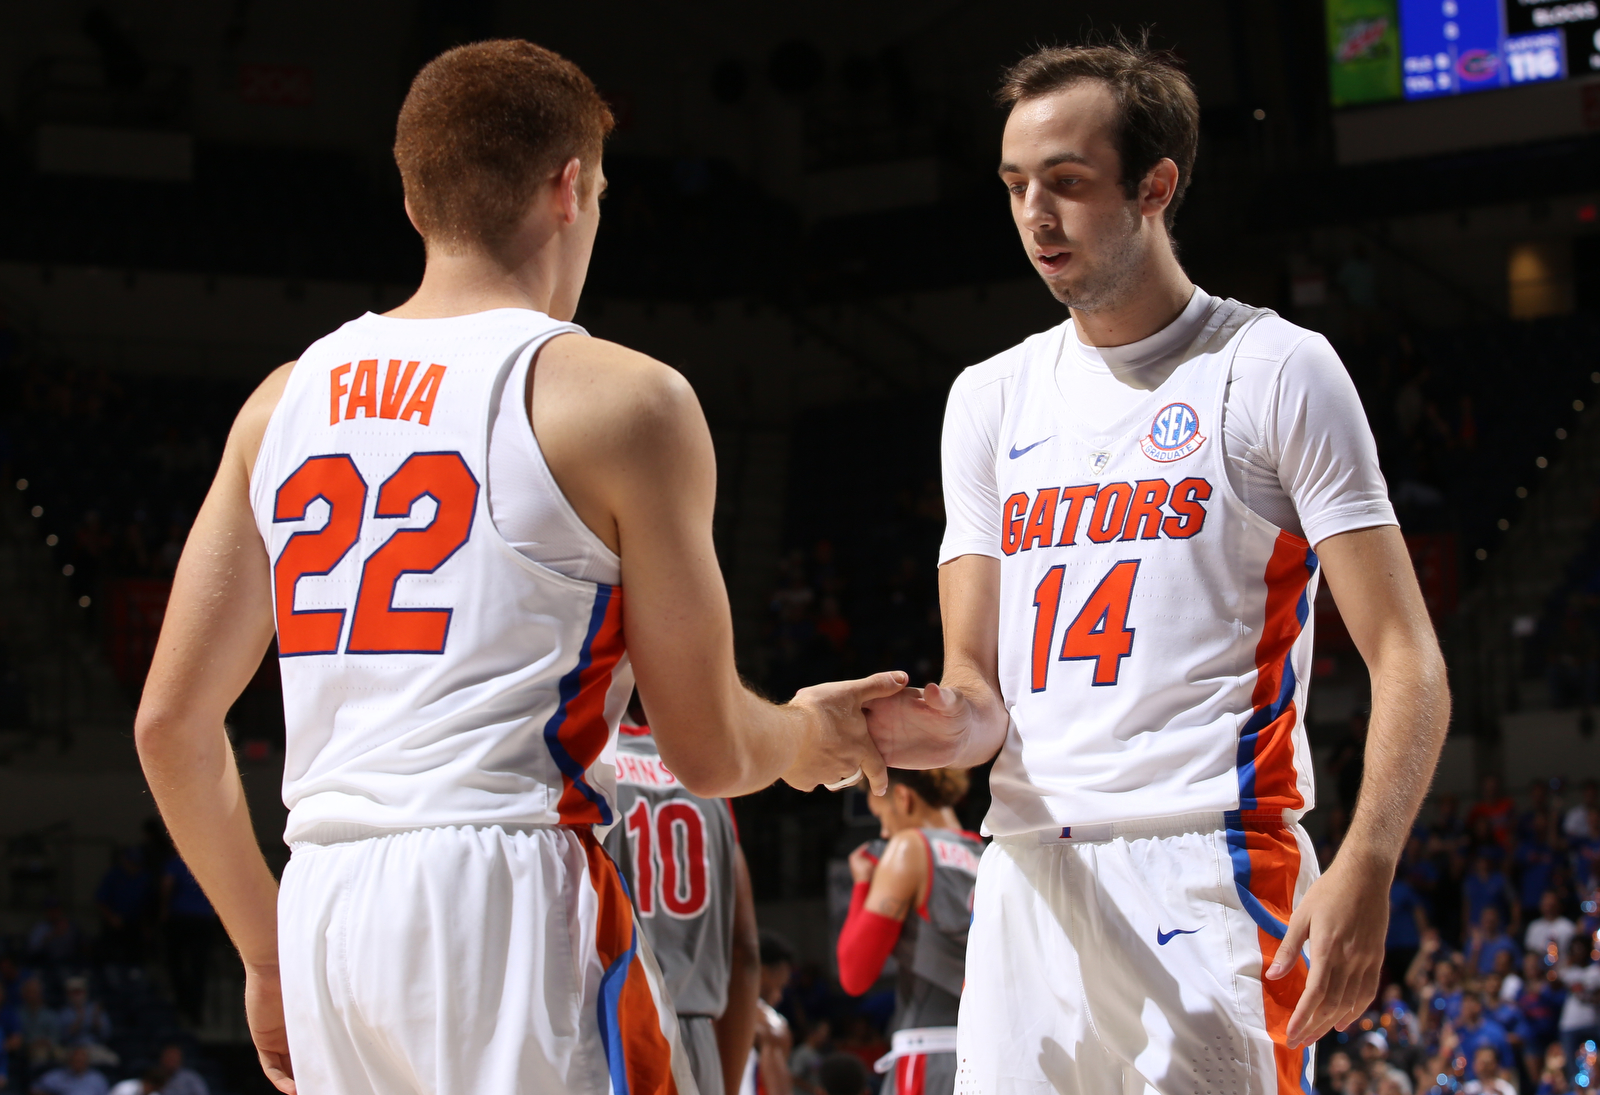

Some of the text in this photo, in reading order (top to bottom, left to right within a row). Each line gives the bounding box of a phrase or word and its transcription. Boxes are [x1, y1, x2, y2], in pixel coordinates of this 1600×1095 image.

[330, 359, 447, 426] FAVA
[1155, 406, 1194, 446] SEC
[1145, 443, 1194, 460] GRADUATE
[272, 451, 480, 658] 22
[1001, 477, 1213, 556] GATORS
[1031, 559, 1141, 693] 14
[624, 796, 711, 919] 10
